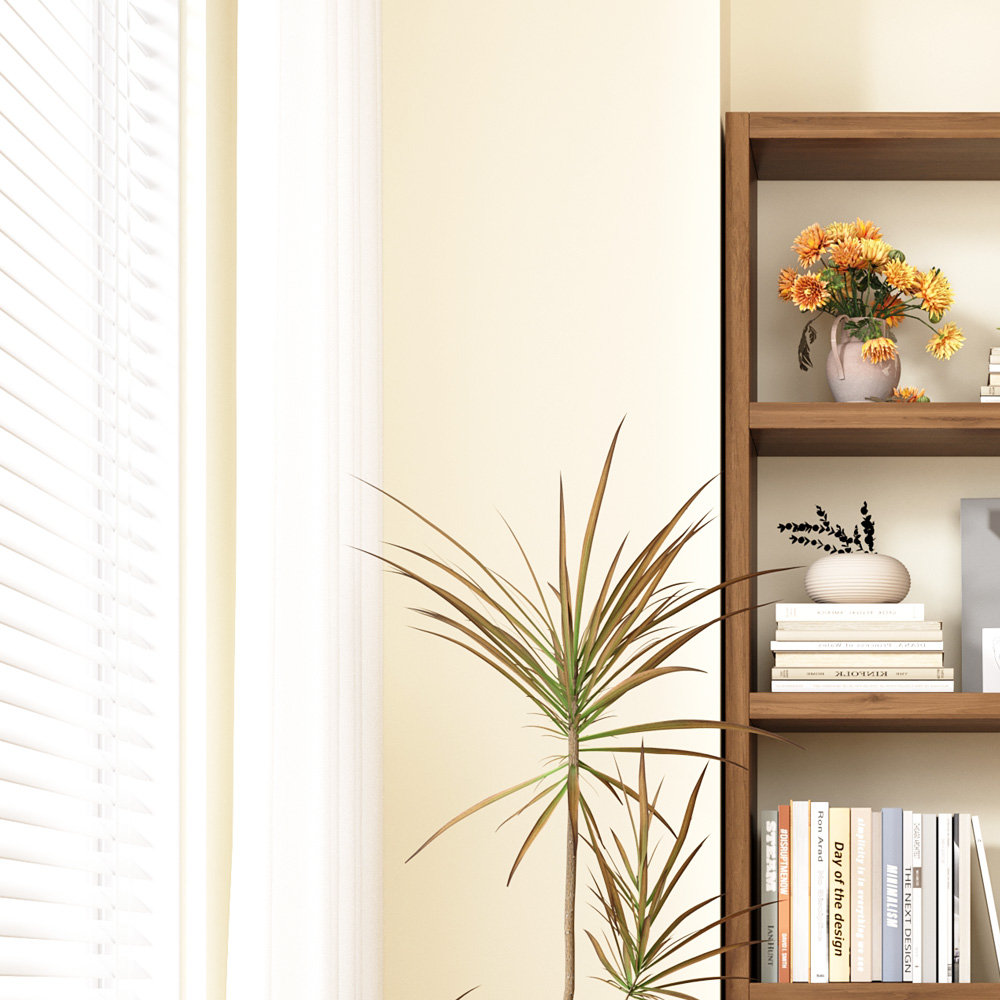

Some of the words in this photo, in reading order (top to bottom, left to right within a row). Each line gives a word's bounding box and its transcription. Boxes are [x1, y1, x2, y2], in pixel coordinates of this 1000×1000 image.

[765, 820, 777, 892] STEAM
[779, 828, 789, 895] #DISRUPTMENOW
[832, 841, 844, 867] Day
[834, 871, 844, 886] of
[904, 867, 912, 888] THE
[834, 887, 844, 909] the
[886, 864, 898, 929] MINIMALISM
[904, 893, 912, 924] NEXT
[832, 913, 844, 957] design
[904, 928, 912, 974] DESIGN
